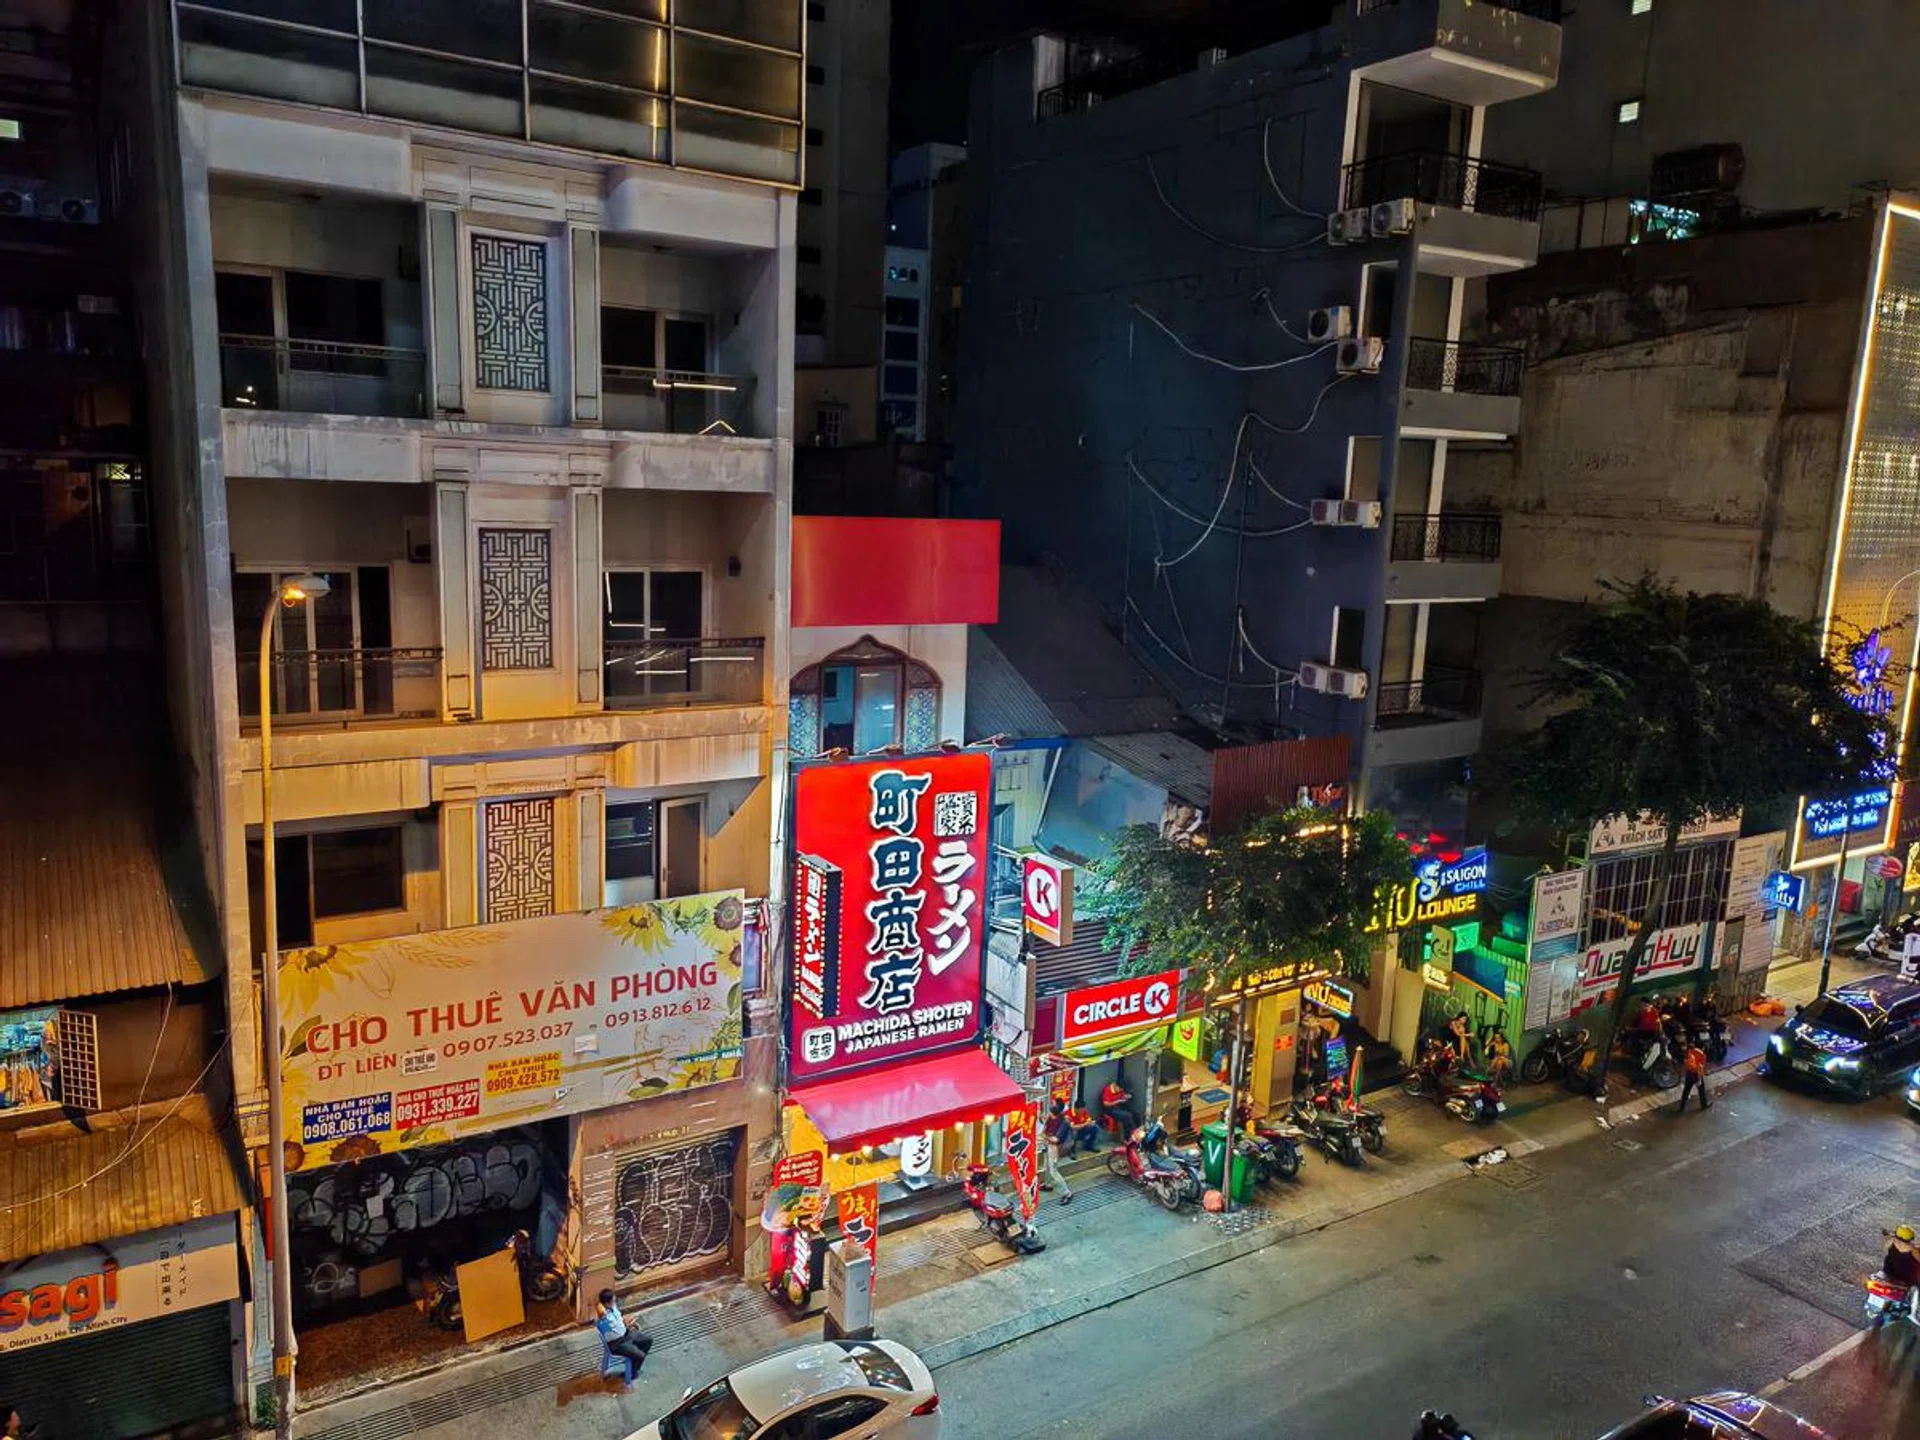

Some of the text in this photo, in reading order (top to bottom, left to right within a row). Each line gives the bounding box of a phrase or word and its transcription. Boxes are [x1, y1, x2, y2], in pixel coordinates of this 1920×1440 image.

[860, 769, 932, 1015] 町田商店
[926, 840, 976, 975] ラーメン
[1417, 893, 1477, 920] LOUNGE
[306, 960, 718, 1054] CHO THUÊ VĂN PHÒNG
[836, 1000, 973, 1041] MACHIDA SHOTEN
[1073, 992, 1142, 1026] CIRCLE
[318, 1062, 346, 1081] ĐT
[443, 1021, 574, 1058] 0907.523.037
[844, 1018, 964, 1054] JAPANESE RAMEN
[487, 1069, 560, 1093] 0909.428.572
[397, 1092, 478, 1122] 0931.339.227
[304, 1112, 390, 1139] 0908.061.068
[9, 1335, 42, 1349] District
